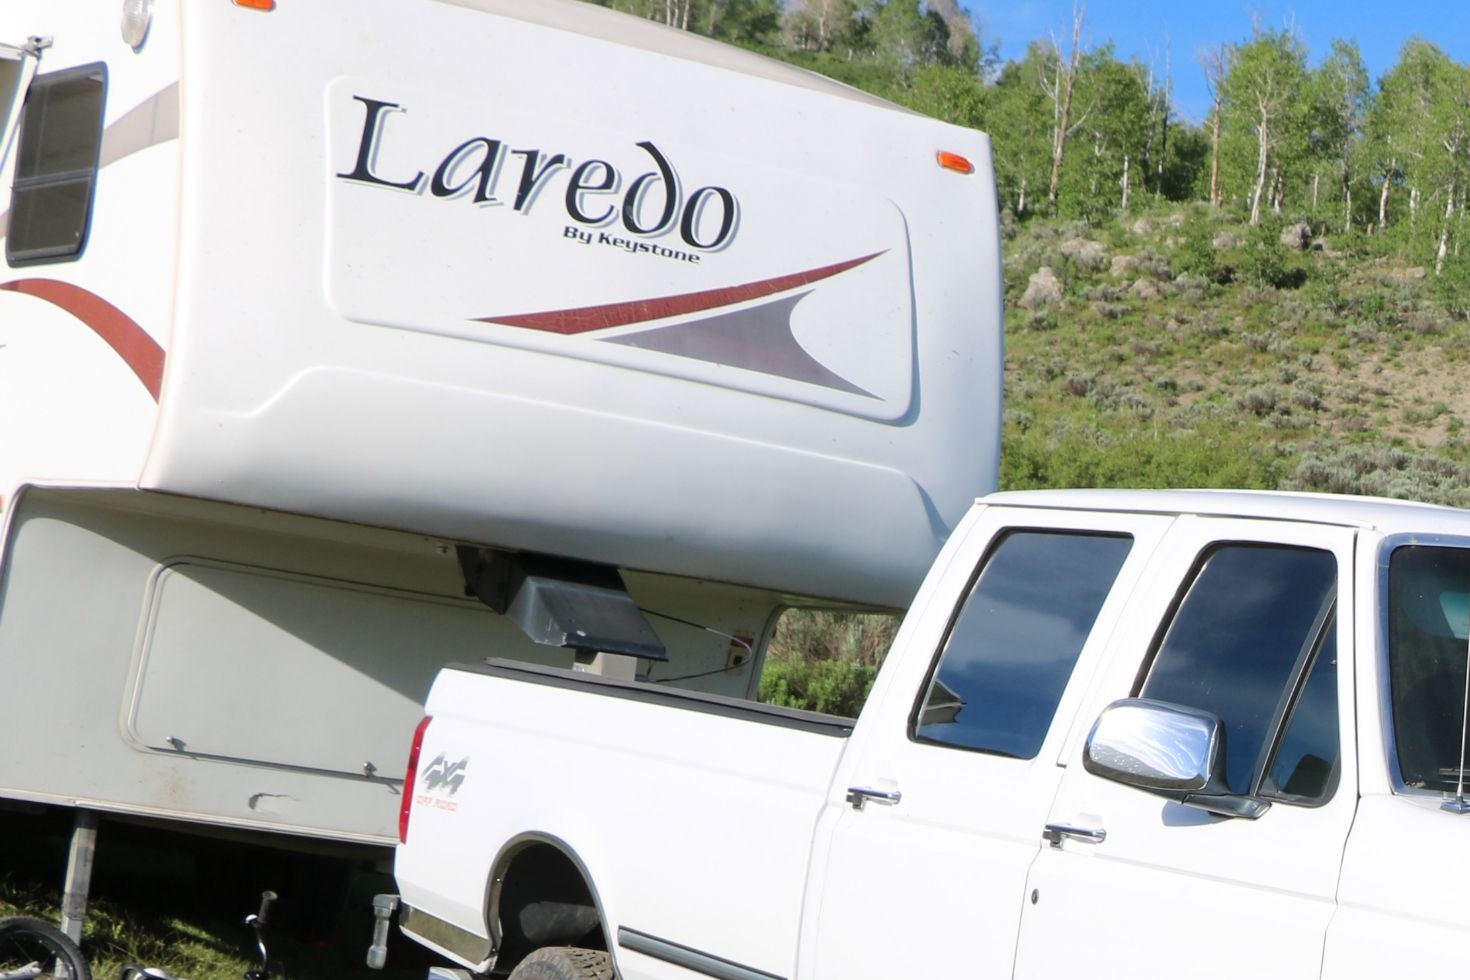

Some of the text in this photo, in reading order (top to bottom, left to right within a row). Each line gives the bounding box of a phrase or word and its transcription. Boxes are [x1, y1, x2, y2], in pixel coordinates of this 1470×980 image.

[336, 95, 741, 253] Laredo
[562, 225, 701, 265] By Keystone
